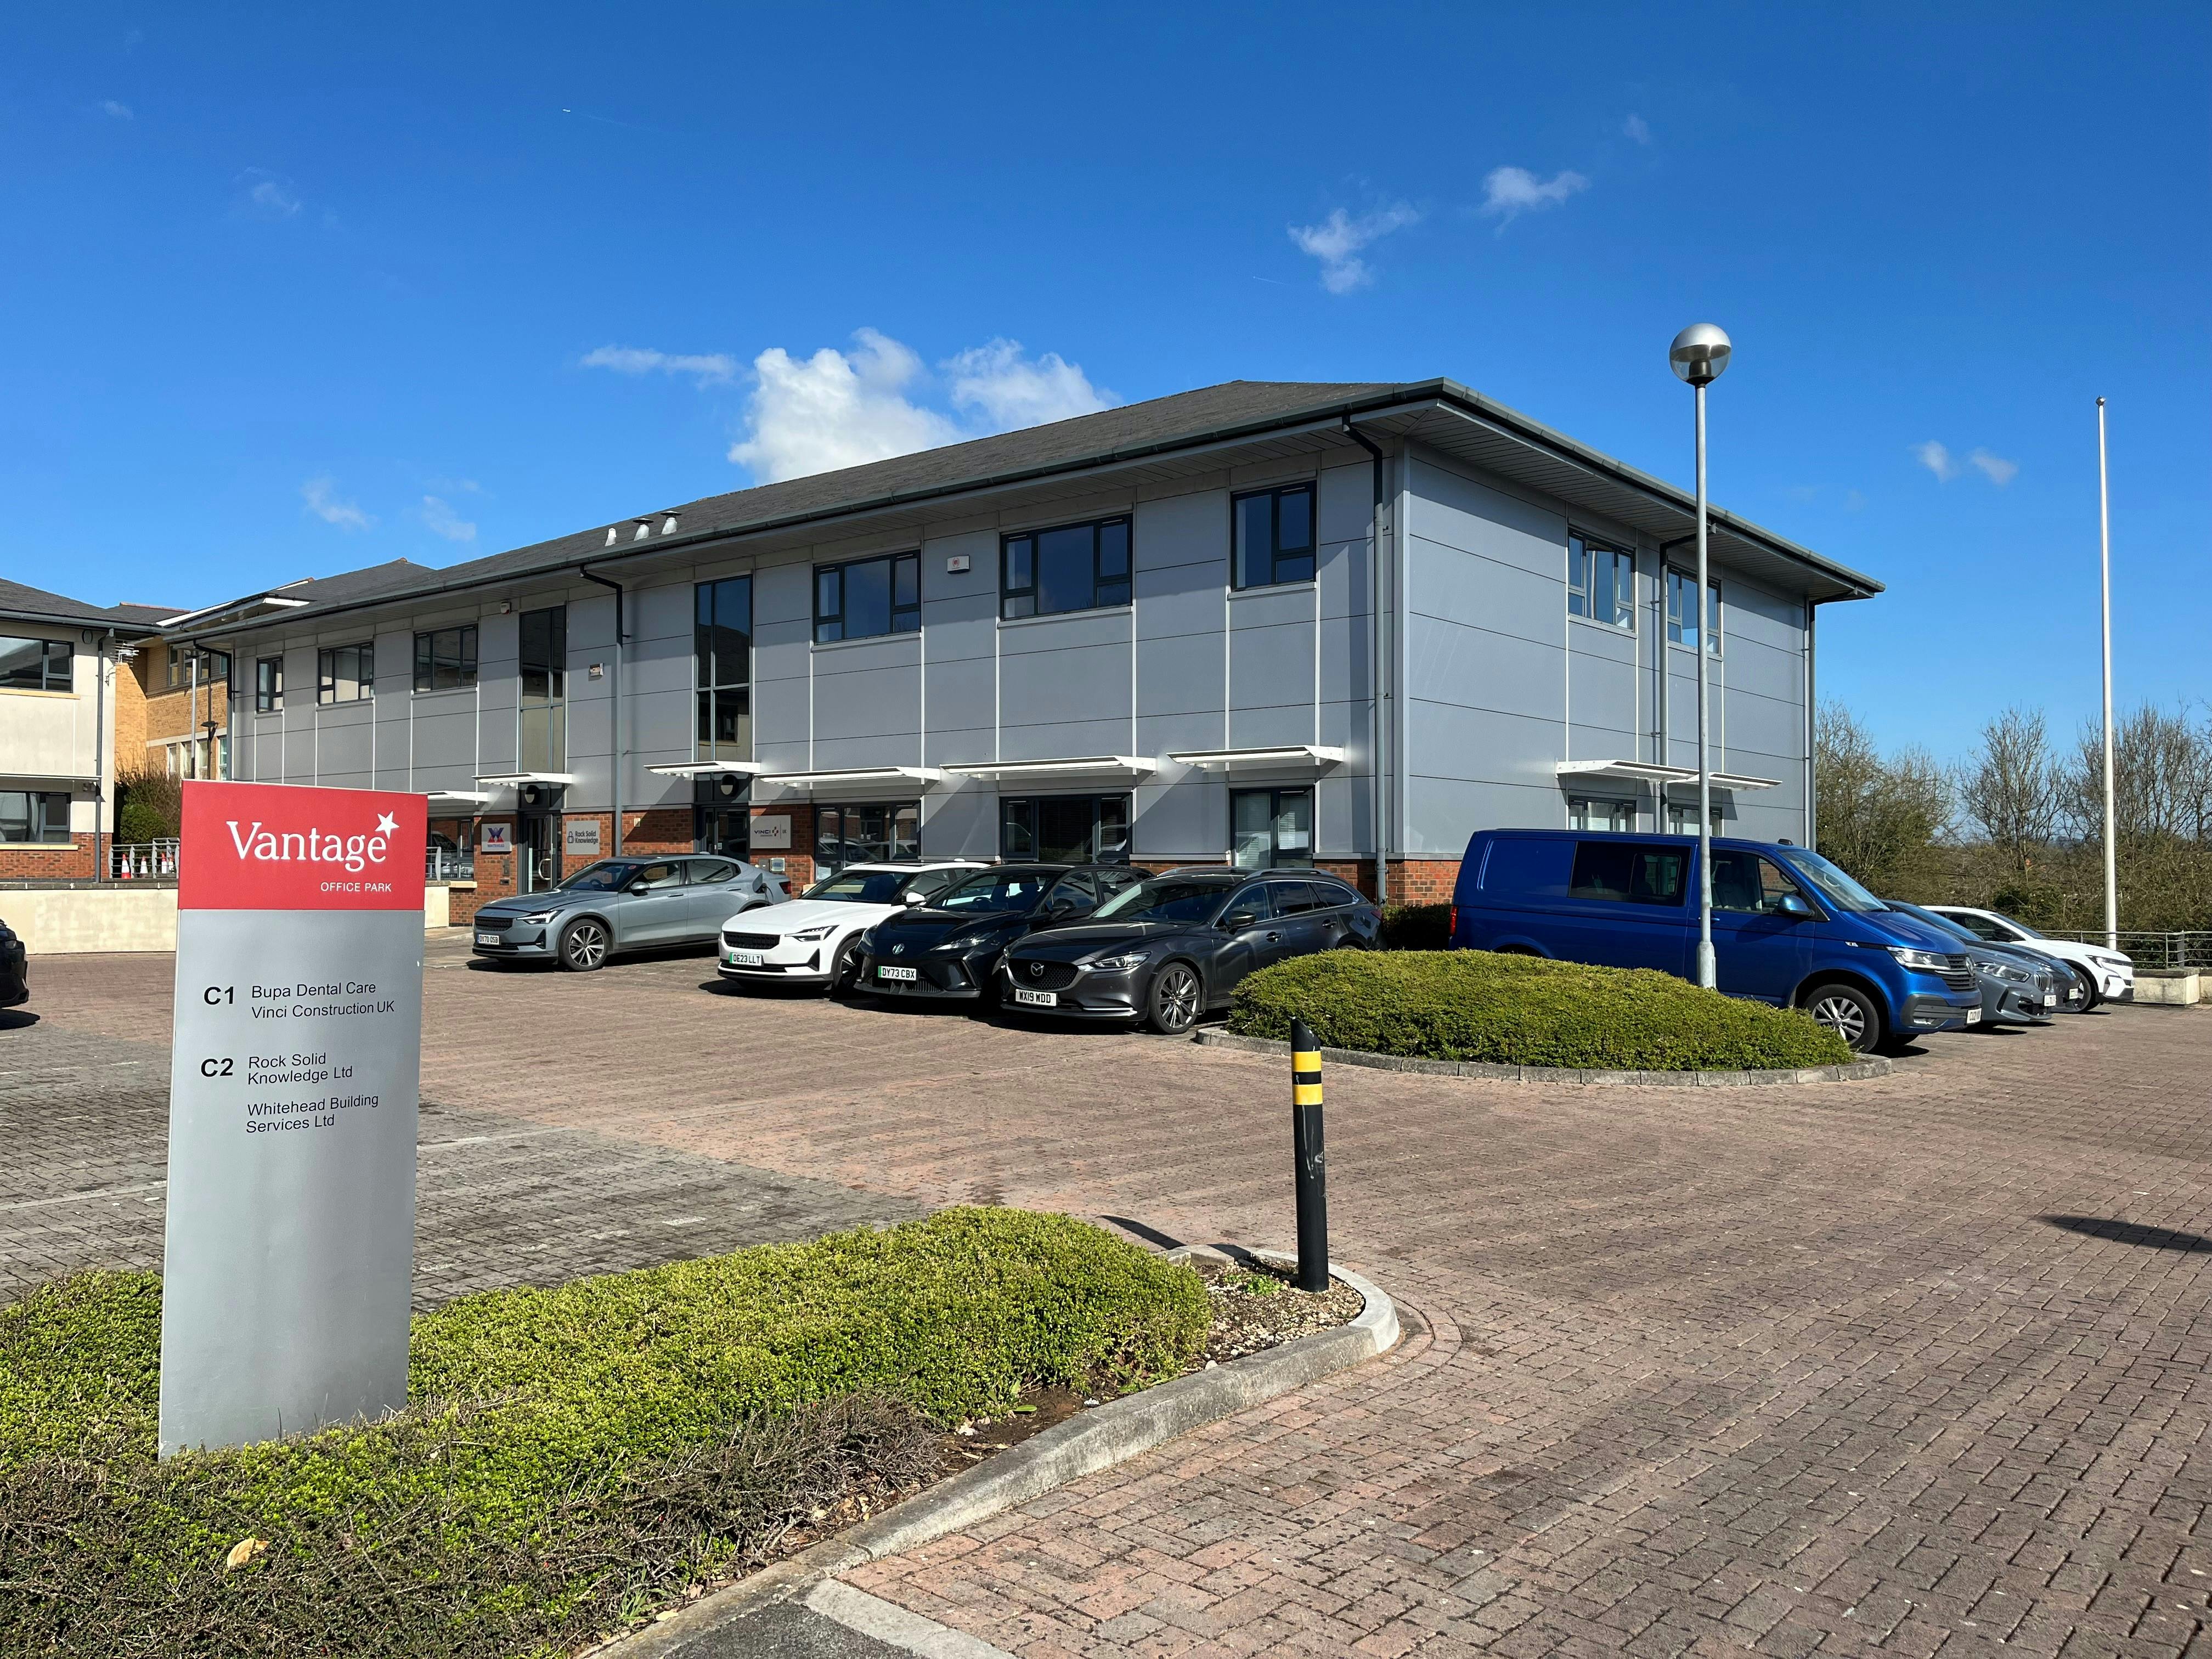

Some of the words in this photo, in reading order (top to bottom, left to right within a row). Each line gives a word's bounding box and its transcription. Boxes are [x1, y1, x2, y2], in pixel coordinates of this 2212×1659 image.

[225, 821, 386, 872] Vantage
[320, 882, 360, 891] OFFICE
[365, 883, 392, 892] PARK
[733, 954, 748, 963] OE23
[749, 955, 760, 964] LLT
[882, 968, 900, 977] DY73
[901, 969, 915, 978] CBX
[204, 986, 234, 1005] C1
[252, 985, 291, 1000] Bupa
[297, 982, 341, 996] Dental
[346, 981, 376, 994] Care
[1036, 993, 1051, 1003] WDD
[251, 1005, 287, 1019] Vinci
[292, 1002, 374, 1017] Construction
[377, 1000, 394, 1013] UK
[201, 1058, 234, 1077] C2
[249, 1055, 286, 1069] Rock
[291, 1052, 326, 1066] Solid
[248, 1069, 329, 1085] Knowledge
[334, 1065, 353, 1079] Ltd
[247, 1098, 325, 1116] Whitehead
[330, 1094, 379, 1109] Building
[246, 1118, 309, 1133] Services
[315, 1114, 335, 1127] Ltd
